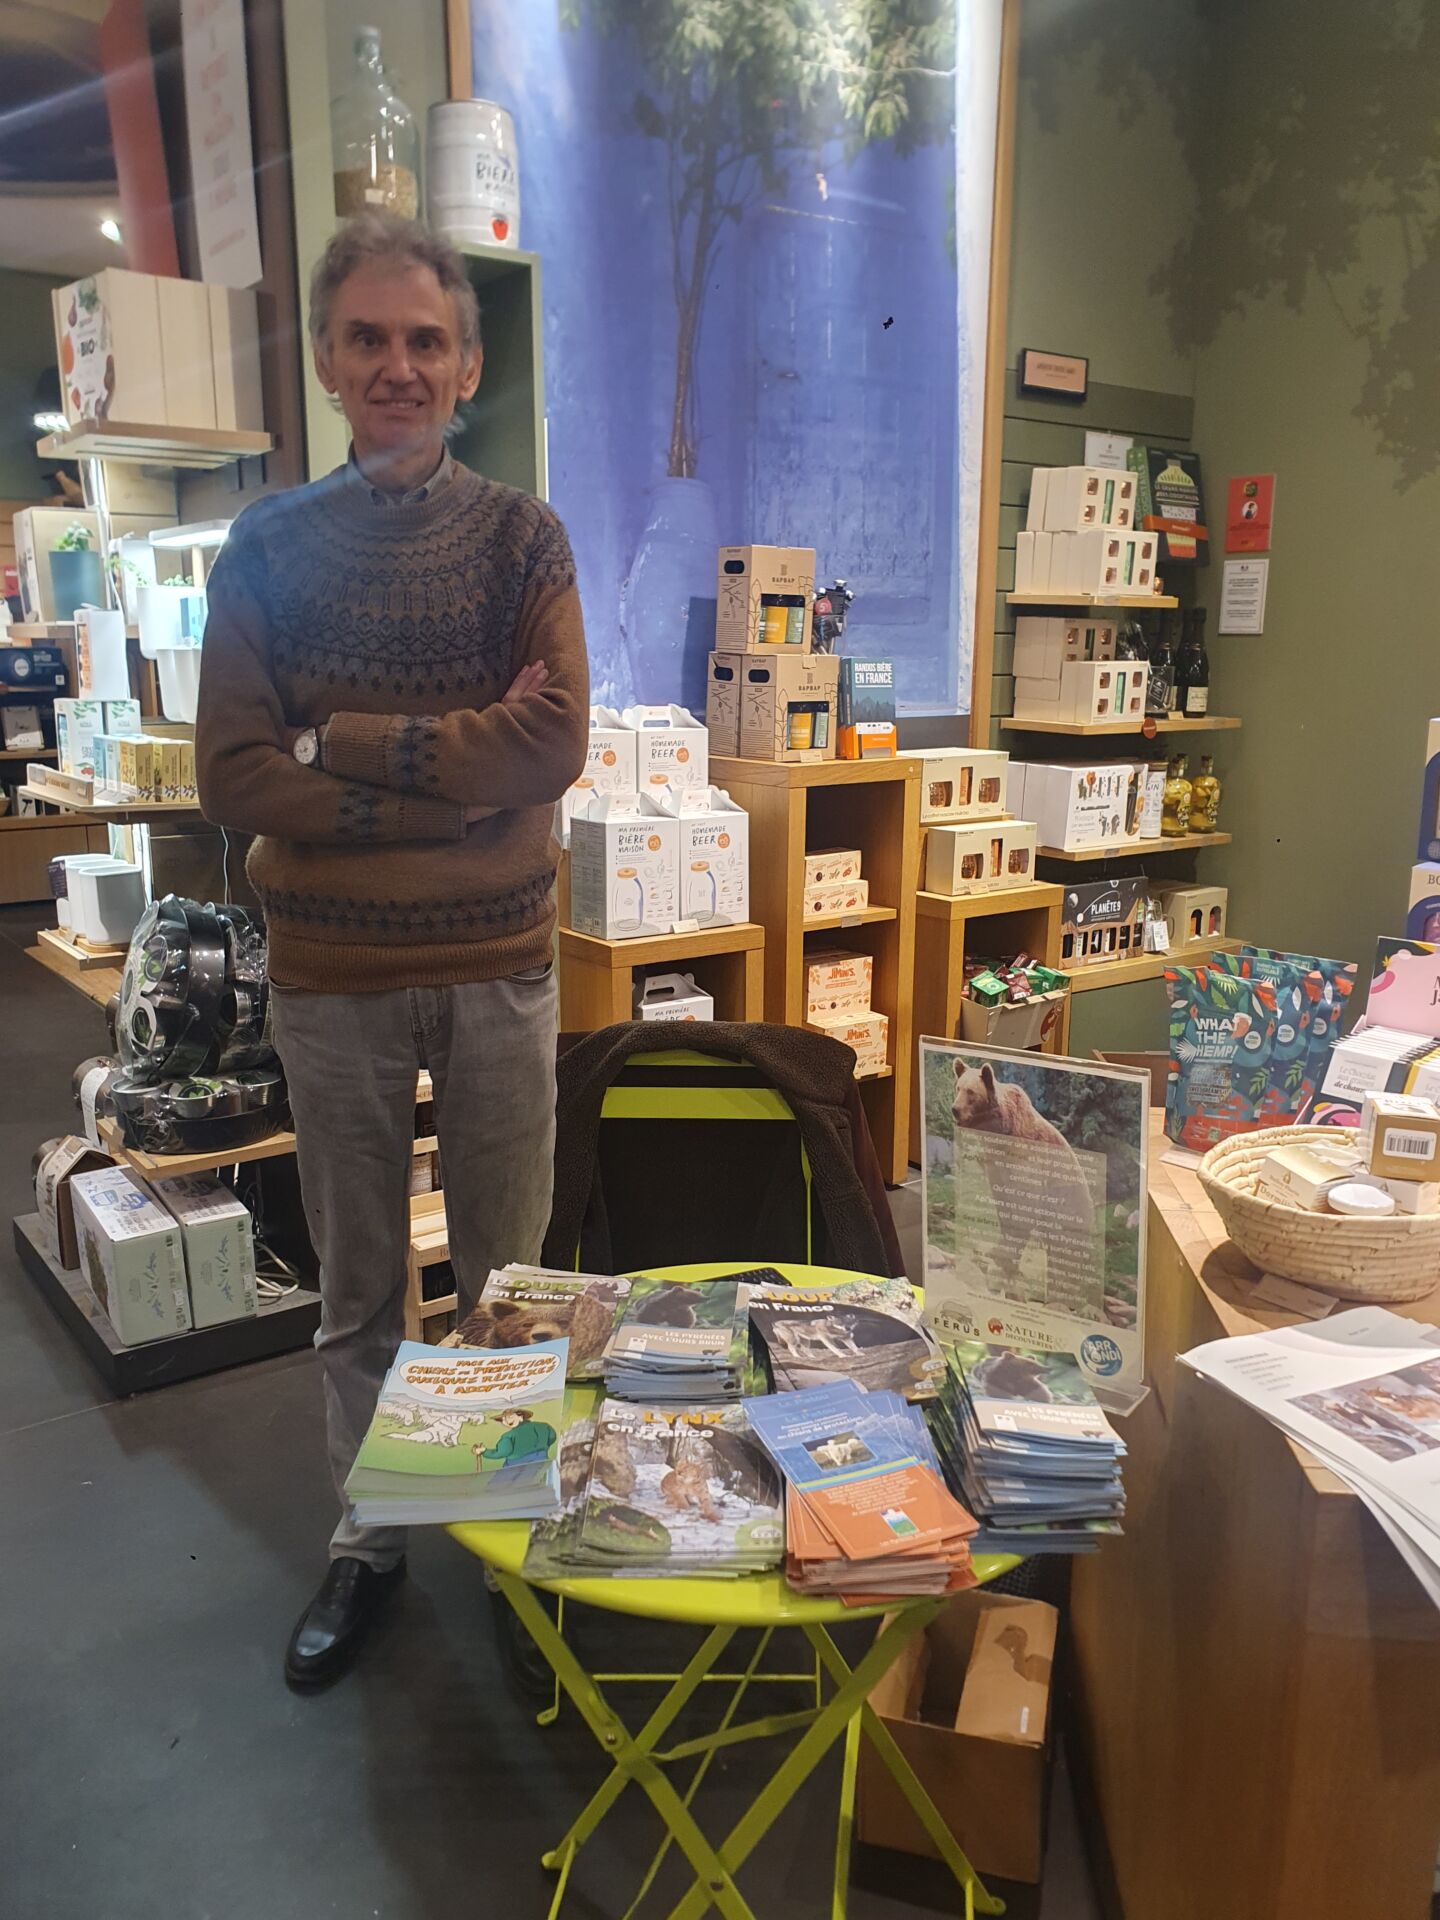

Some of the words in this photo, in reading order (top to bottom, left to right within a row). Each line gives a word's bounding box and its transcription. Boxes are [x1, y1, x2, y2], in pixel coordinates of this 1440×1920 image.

[81, 338, 95, 357] BIO
[854, 662, 876, 672] RANDOS
[855, 673, 865, 684] EN
[866, 672, 892, 684] FRANCE
[588, 751, 601, 761] ER
[651, 748, 675, 759] BEER
[691, 825, 726, 834] HOMEMADE
[618, 834, 645, 844] BIÈRE
[692, 835, 716, 846] BEER
[1196, 1018, 1238, 1031] WHAT
[1196, 1031, 1227, 1044] THE
[1196, 1045, 1238, 1058] HEMP!
[1334, 1080, 1343, 1088] de
[1026, 1191, 1041, 1201] que
[1006, 1202, 1017, 1210] est
[1018, 1204, 1033, 1212] une
[1034, 1206, 1056, 1217] action
[1057, 1211, 1074, 1221] pour
[488, 1289, 506, 1299] en
[513, 1290, 576, 1301] France
[767, 1291, 833, 1302] LOUP
[749, 1301, 770, 1310] en
[772, 1302, 834, 1312] France
[934, 1317, 980, 1337] FERUS
[642, 1333, 664, 1342] AVEC
[1005, 1322, 1053, 1344] NATURE
[488, 1358, 513, 1367] AUX
[405, 1375, 479, 1385] QUELQUES
[481, 1364, 556, 1383] RÉFLEXES
[408, 1365, 458, 1376] CHIENS
[1004, 1409, 1031, 1419] AVEC
[1026, 1406, 1045, 1415] LES
[610, 1408, 635, 1420] Le
[642, 1410, 725, 1425] LYNX
[607, 1423, 633, 1434] en
[637, 1425, 715, 1441] France
